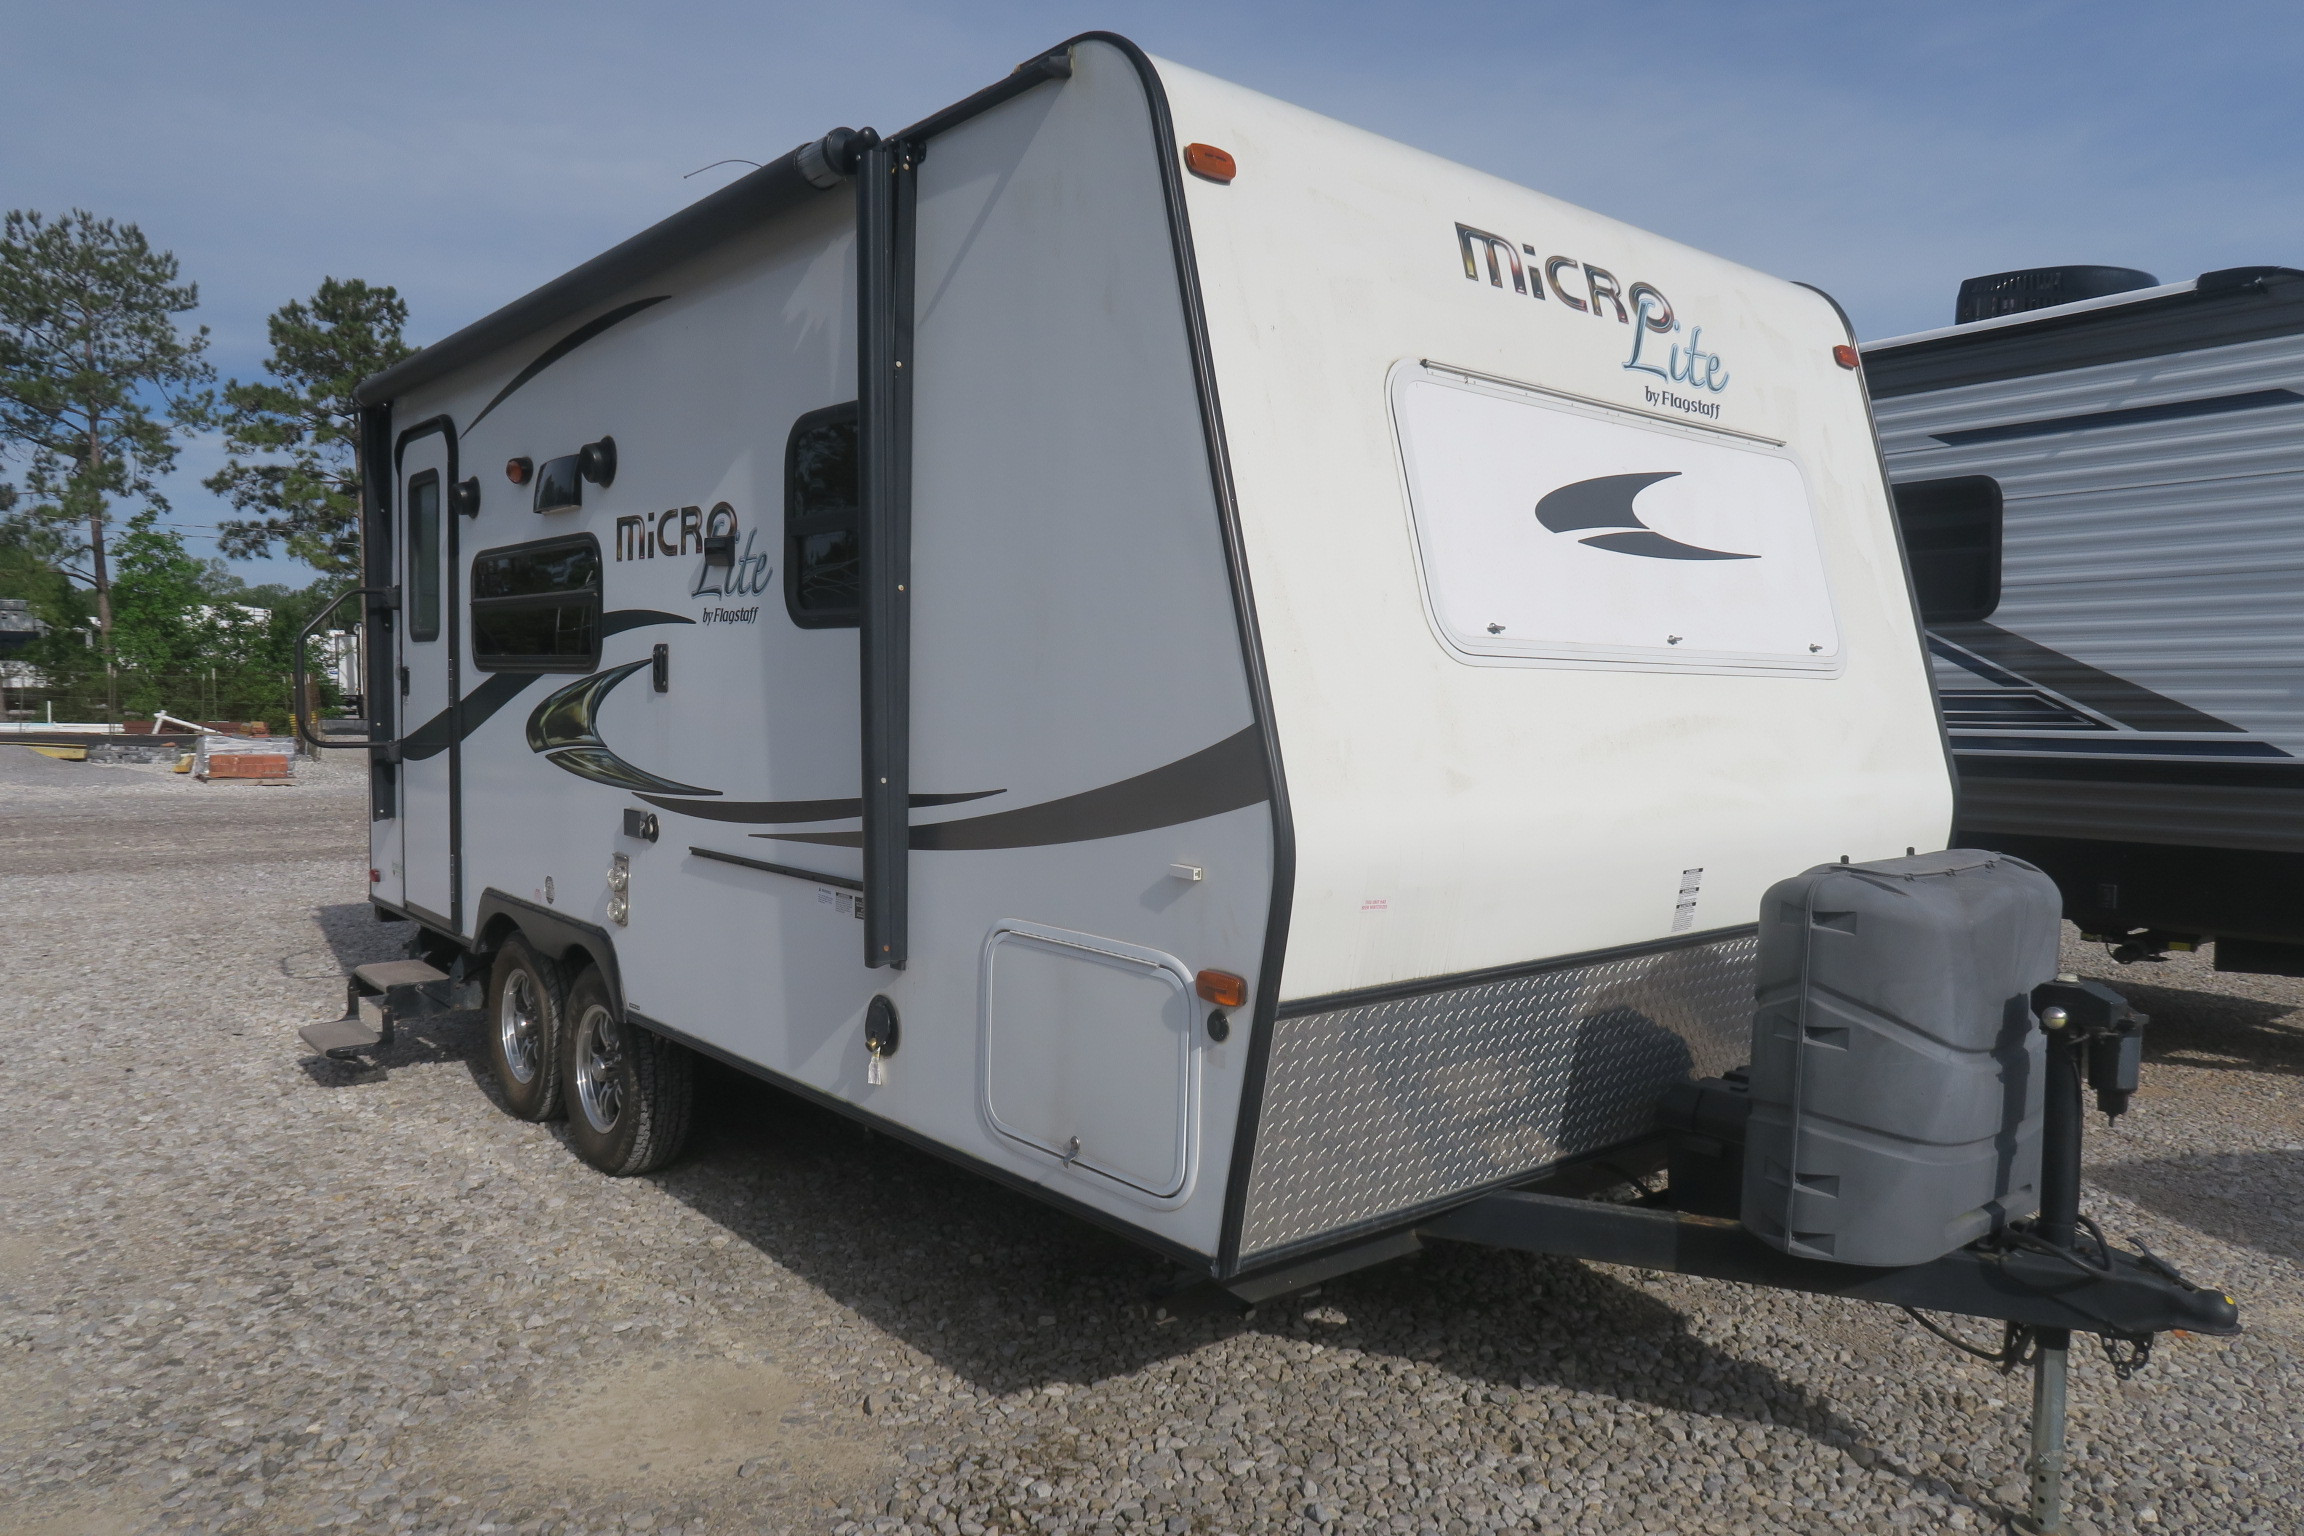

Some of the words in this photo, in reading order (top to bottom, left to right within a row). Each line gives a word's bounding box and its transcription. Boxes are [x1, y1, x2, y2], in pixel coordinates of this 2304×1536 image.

[1622, 299, 1730, 391] Lite
[1644, 386, 1660, 407] by
[1661, 390, 1721, 420] Flagstaff
[702, 607, 714, 626] by
[714, 606, 759, 624] Flagstaff
